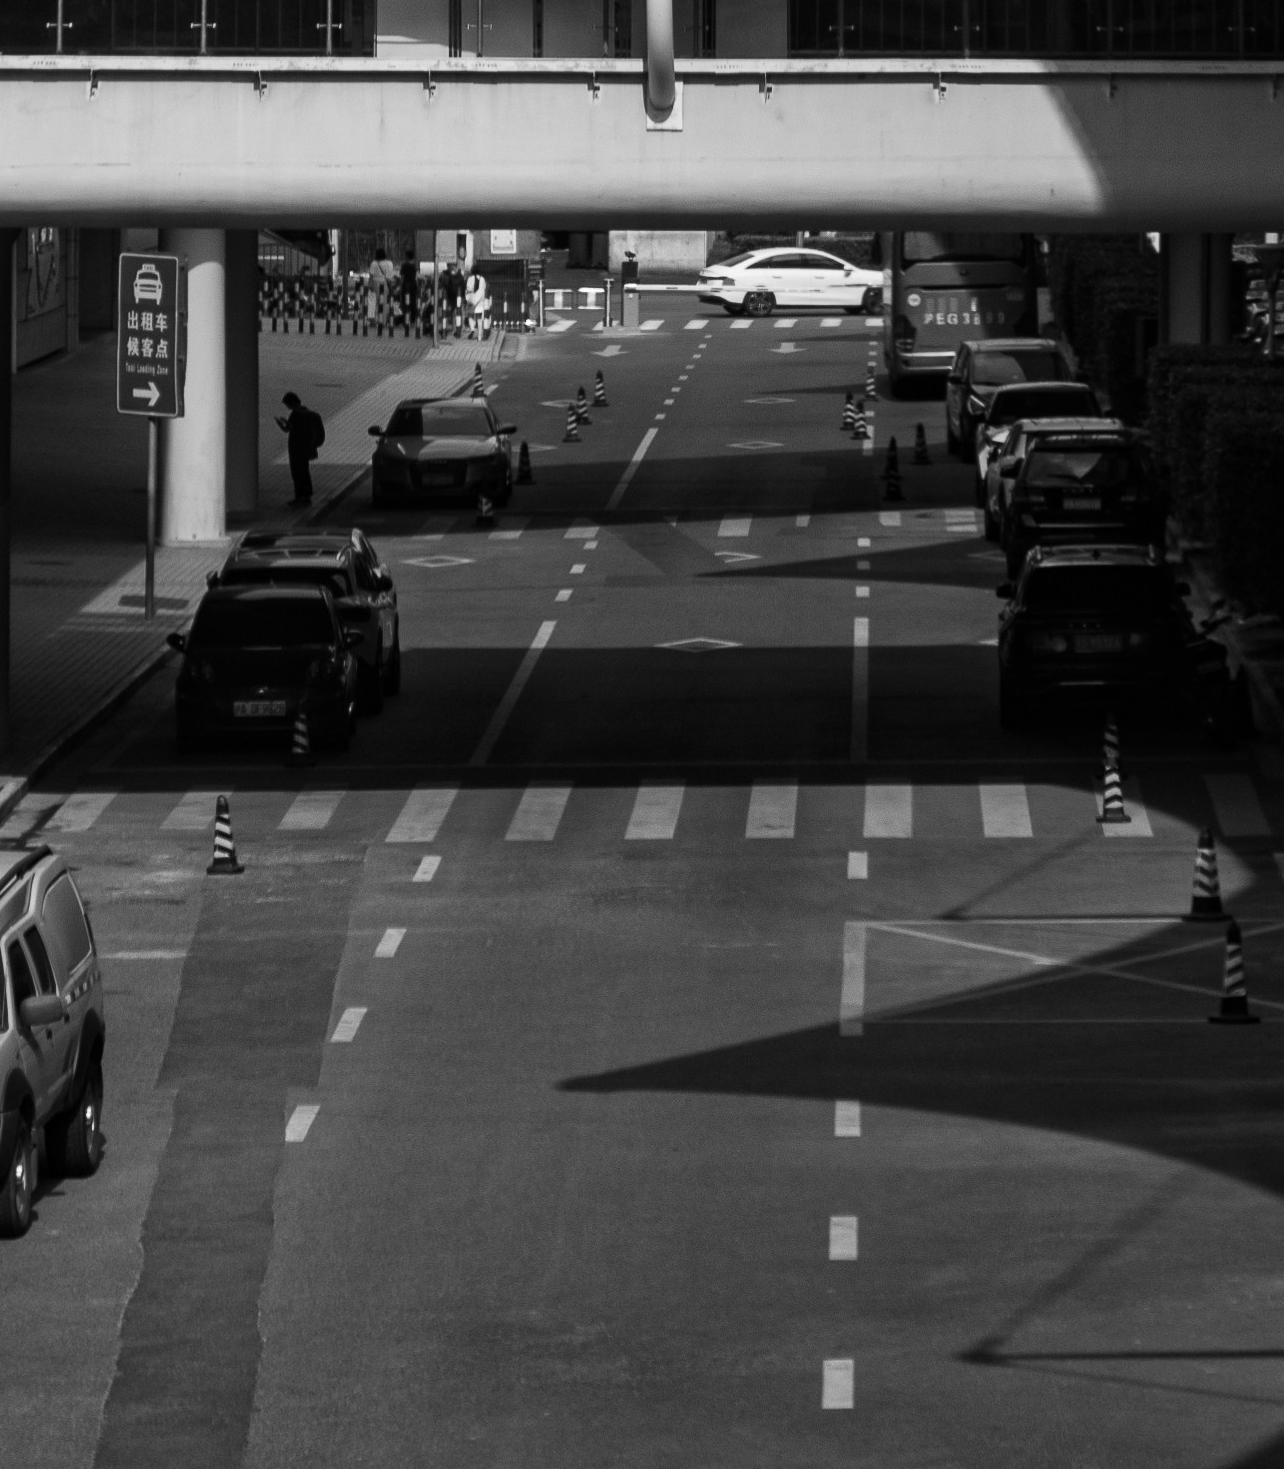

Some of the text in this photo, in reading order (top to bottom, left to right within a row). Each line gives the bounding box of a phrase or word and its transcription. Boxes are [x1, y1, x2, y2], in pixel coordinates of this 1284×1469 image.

[127, 310, 168, 333] 出租车
[127, 336, 168, 359] 候客点
[156, 364, 168, 375] Zone
